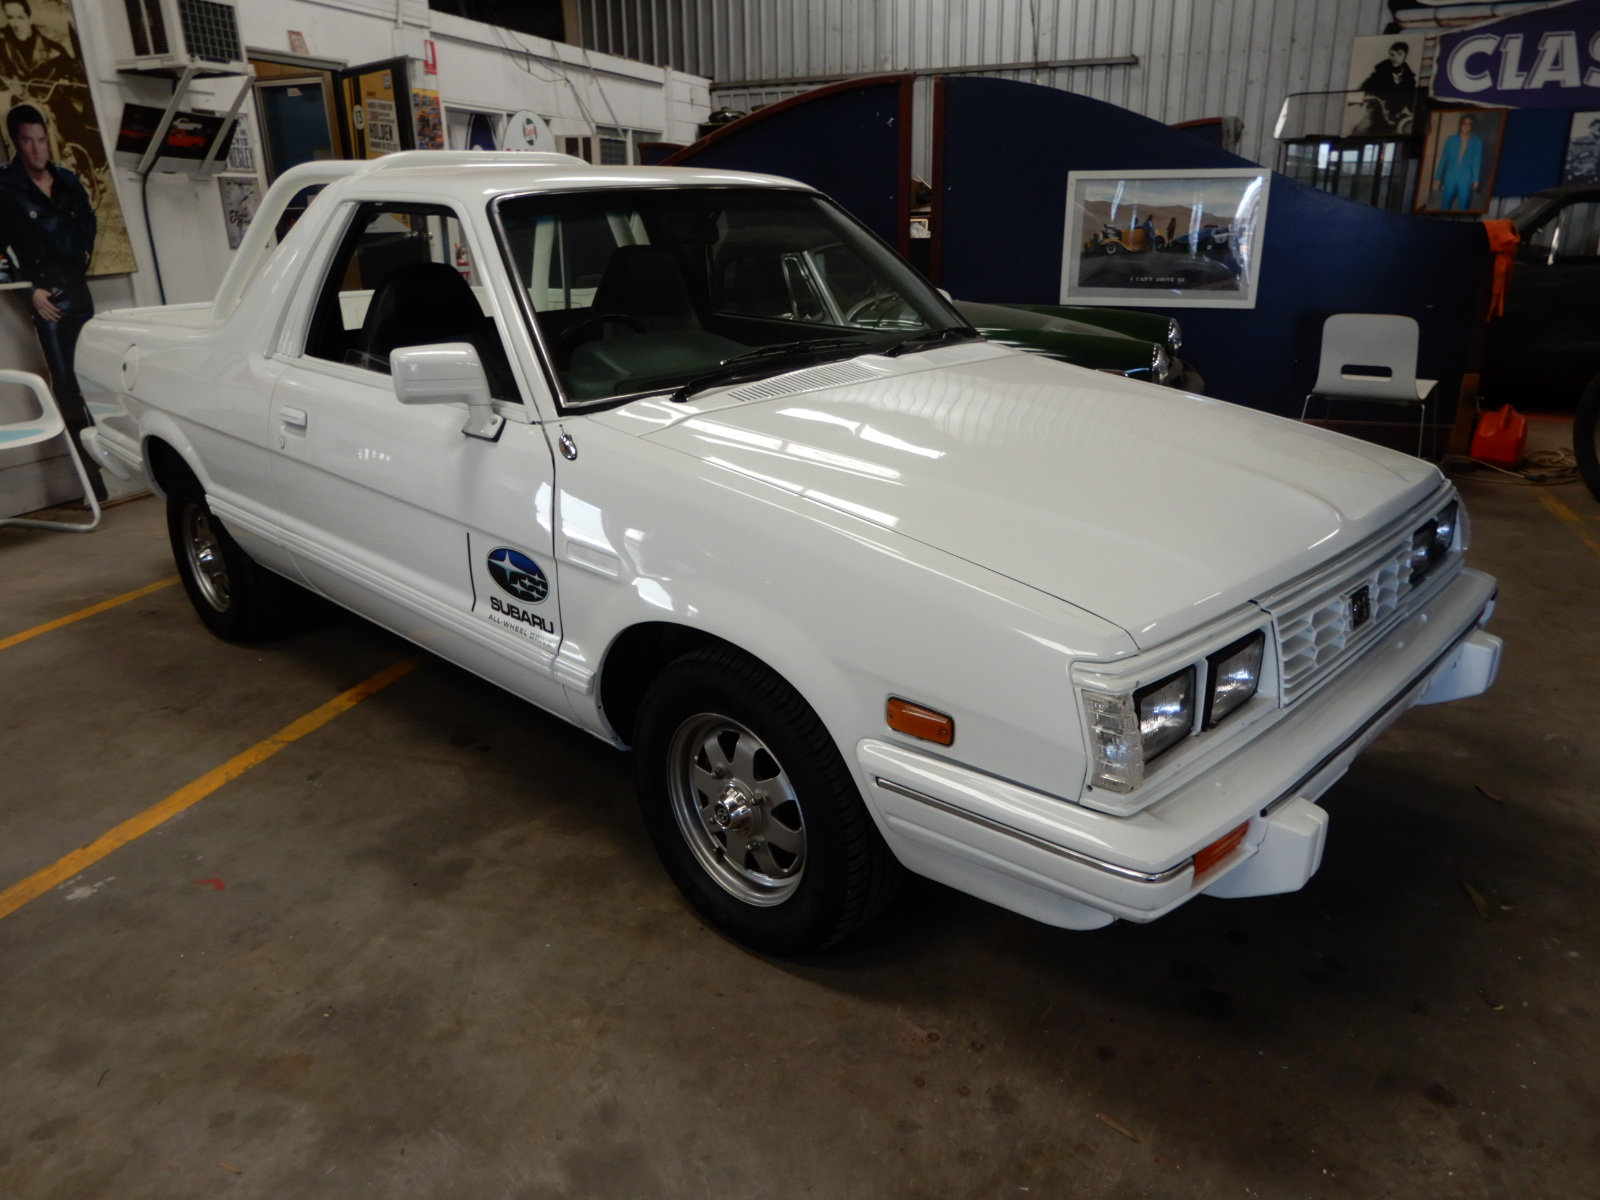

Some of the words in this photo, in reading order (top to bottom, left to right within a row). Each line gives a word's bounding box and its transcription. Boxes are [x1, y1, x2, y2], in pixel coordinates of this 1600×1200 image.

[368, 122, 393, 141] HOLDEN
[488, 614, 528, 637] ALL-WHEEL
[529, 632, 553, 648] DRIVE
[490, 596, 554, 635] SUBARU
